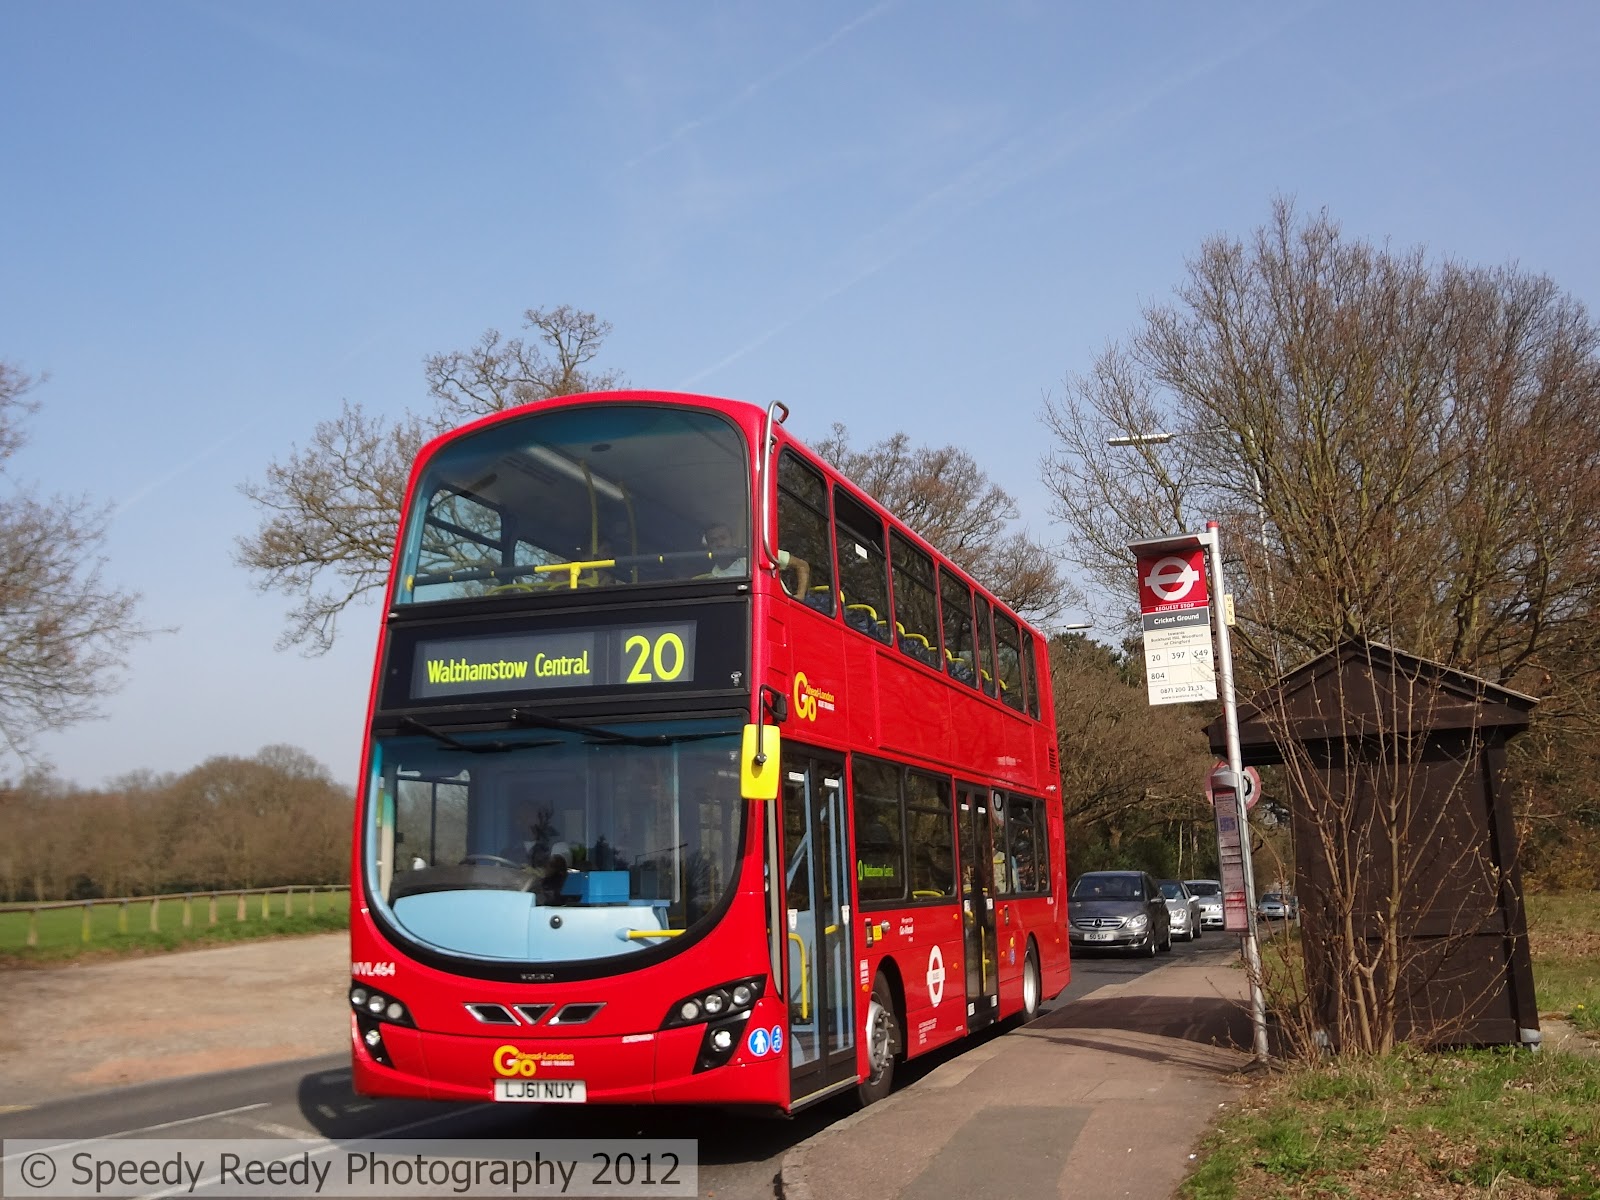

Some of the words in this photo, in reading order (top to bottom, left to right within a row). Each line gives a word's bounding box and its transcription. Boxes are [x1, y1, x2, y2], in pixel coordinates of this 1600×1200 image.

[1155, 604, 1178, 612] REQUEST
[1153, 616, 1176, 625] Cricket
[1177, 613, 1200, 622] Ground
[625, 632, 685, 683] 20
[1151, 654, 1161, 662] 20
[1171, 651, 1185, 660] 397
[1193, 649, 1208, 657] 549
[427, 658, 528, 683] Walthamstow
[534, 650, 590, 677] Central
[1150, 672, 1165, 680] 804
[793, 671, 817, 722] Go
[493, 1044, 537, 1077] Go
[505, 1081, 540, 1098] LJ61
[544, 1081, 575, 1098] NUY
